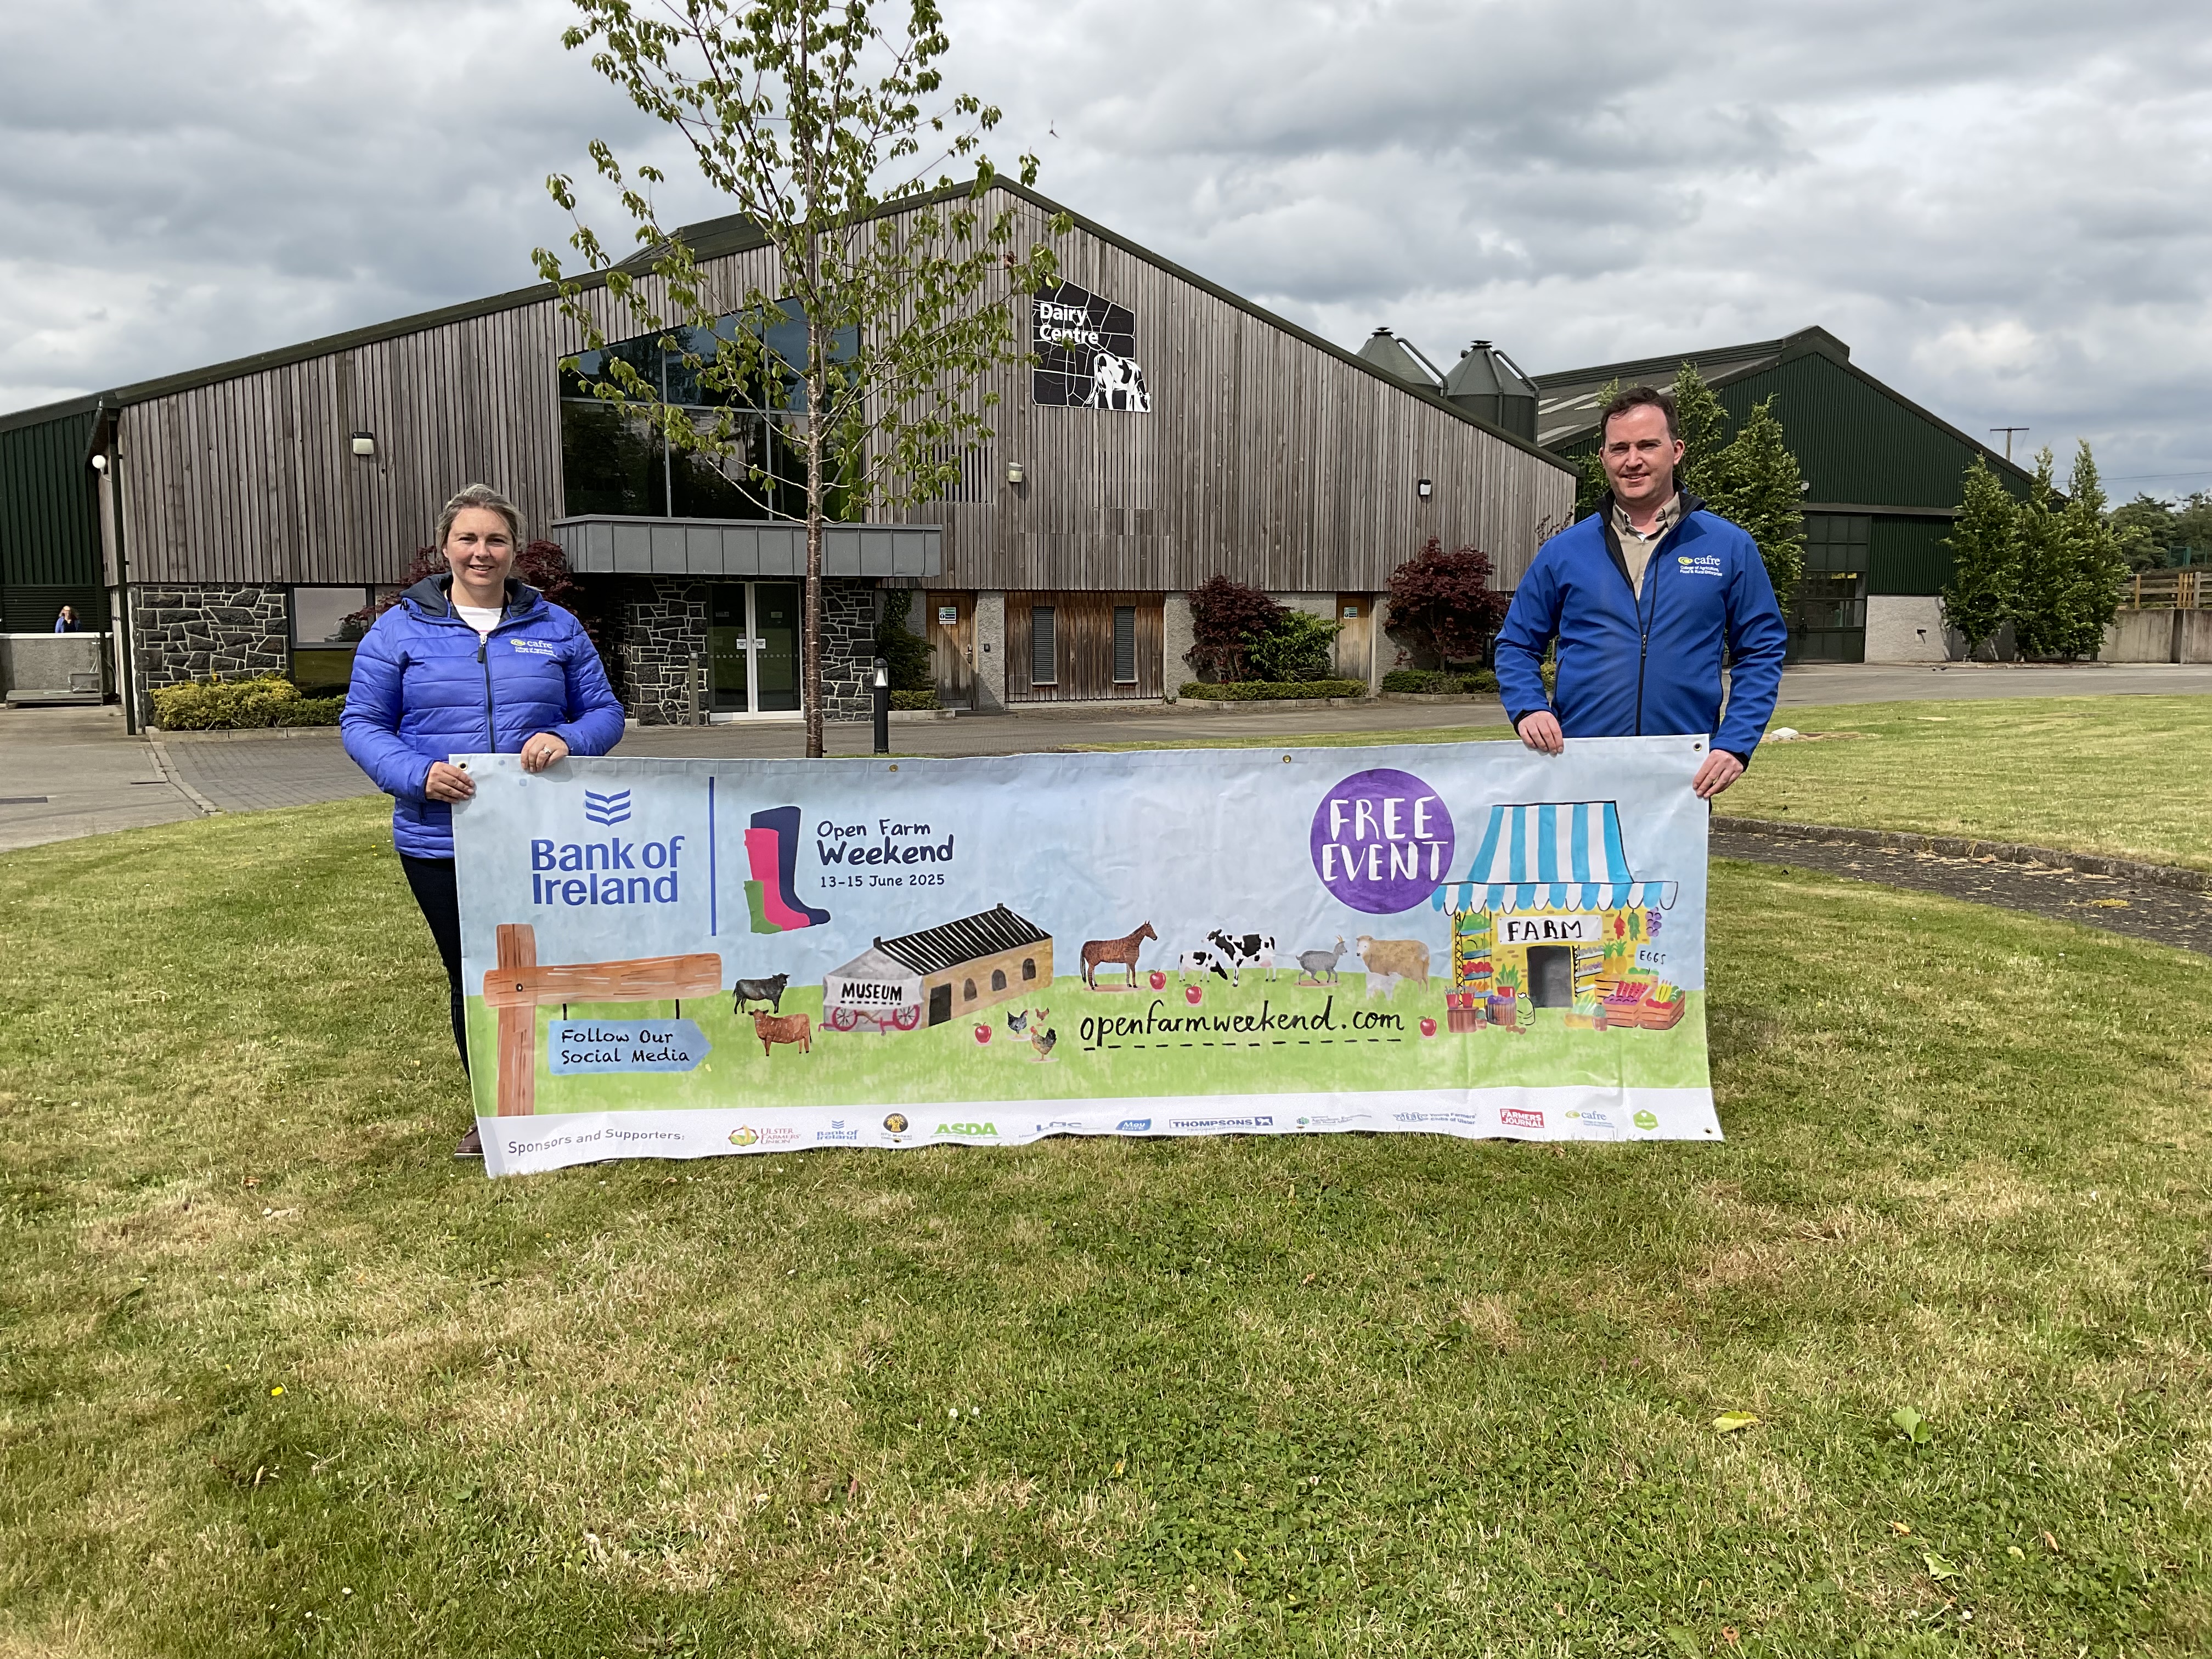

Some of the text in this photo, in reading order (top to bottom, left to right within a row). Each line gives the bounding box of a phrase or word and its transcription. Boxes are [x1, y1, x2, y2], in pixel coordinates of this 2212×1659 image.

[1040, 303, 1087, 326] Dairy
[1039, 324, 1099, 345] Centre
[1694, 555, 1720, 566] cafre
[527, 640, 553, 649] cafre
[1330, 795, 1436, 842] FREE
[817, 819, 931, 841] Open Farm
[531, 836, 685, 871] Bank of
[816, 834, 954, 866] Weekend
[1322, 841, 1448, 881] EVENT
[533, 871, 678, 906] Ireland
[821, 873, 945, 888] 13-15 June 2025
[1507, 919, 1583, 941] FARM
[1639, 950, 1667, 965] EGGS
[841, 983, 902, 1001] MUSEUM
[1080, 995, 1405, 1047] openfarmweekend.com
[562, 1028, 674, 1043] Follow Our
[561, 1047, 690, 1064] Social Media
[1173, 1119, 1253, 1127] THOMPSONS
[1502, 1111, 1542, 1121] FARMERS
[1503, 1117, 1543, 1127] JOURNAL
[1581, 1111, 1607, 1120] cafre
[934, 1122, 998, 1136] ASDA
[508, 1128, 685, 1156] Sponsors and Supporters:
